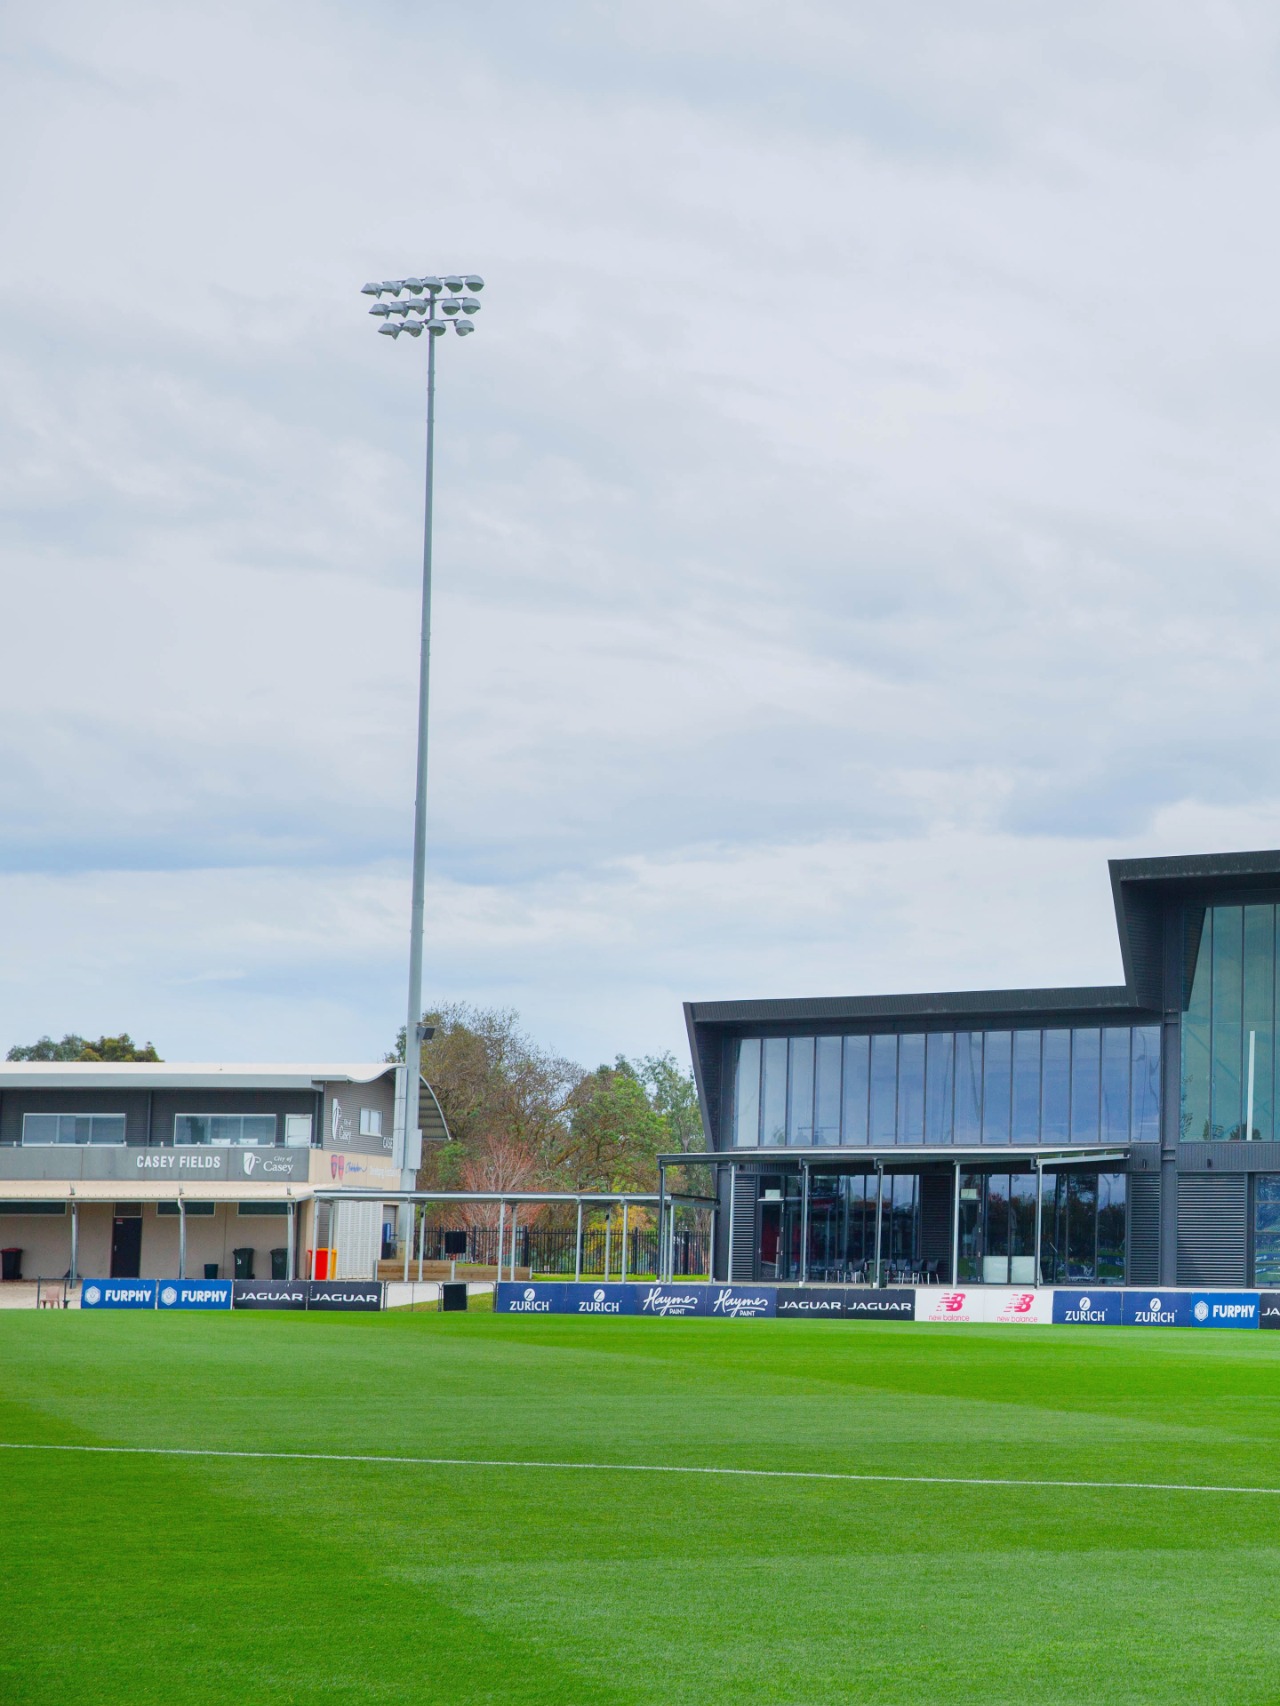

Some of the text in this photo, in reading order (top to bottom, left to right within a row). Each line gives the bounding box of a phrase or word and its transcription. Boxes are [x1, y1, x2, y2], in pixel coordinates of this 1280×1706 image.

[136, 1155, 221, 1169] CASEY FIELDS
[273, 1155, 293, 1163] City of
[263, 1161, 294, 1174] Casey
[105, 1290, 151, 1302] FURPHY
[181, 1290, 228, 1302] FURPHY
[236, 1292, 304, 1301] JAGUAR
[310, 1293, 378, 1303] JAGUAR
[642, 1287, 698, 1316] Haymes
[509, 1301, 550, 1311] ZURICH
[578, 1302, 619, 1312] ZURICH
[713, 1288, 768, 1318] Haymes
[778, 1301, 842, 1310] JAGUAR
[847, 1302, 912, 1311] JAGUAR
[1065, 1310, 1105, 1322] ZURICH
[1212, 1304, 1256, 1318] FURPHY
[942, 1314, 970, 1322] balance
[1011, 1315, 1038, 1323] balance
[1134, 1311, 1175, 1323] ZURICH
